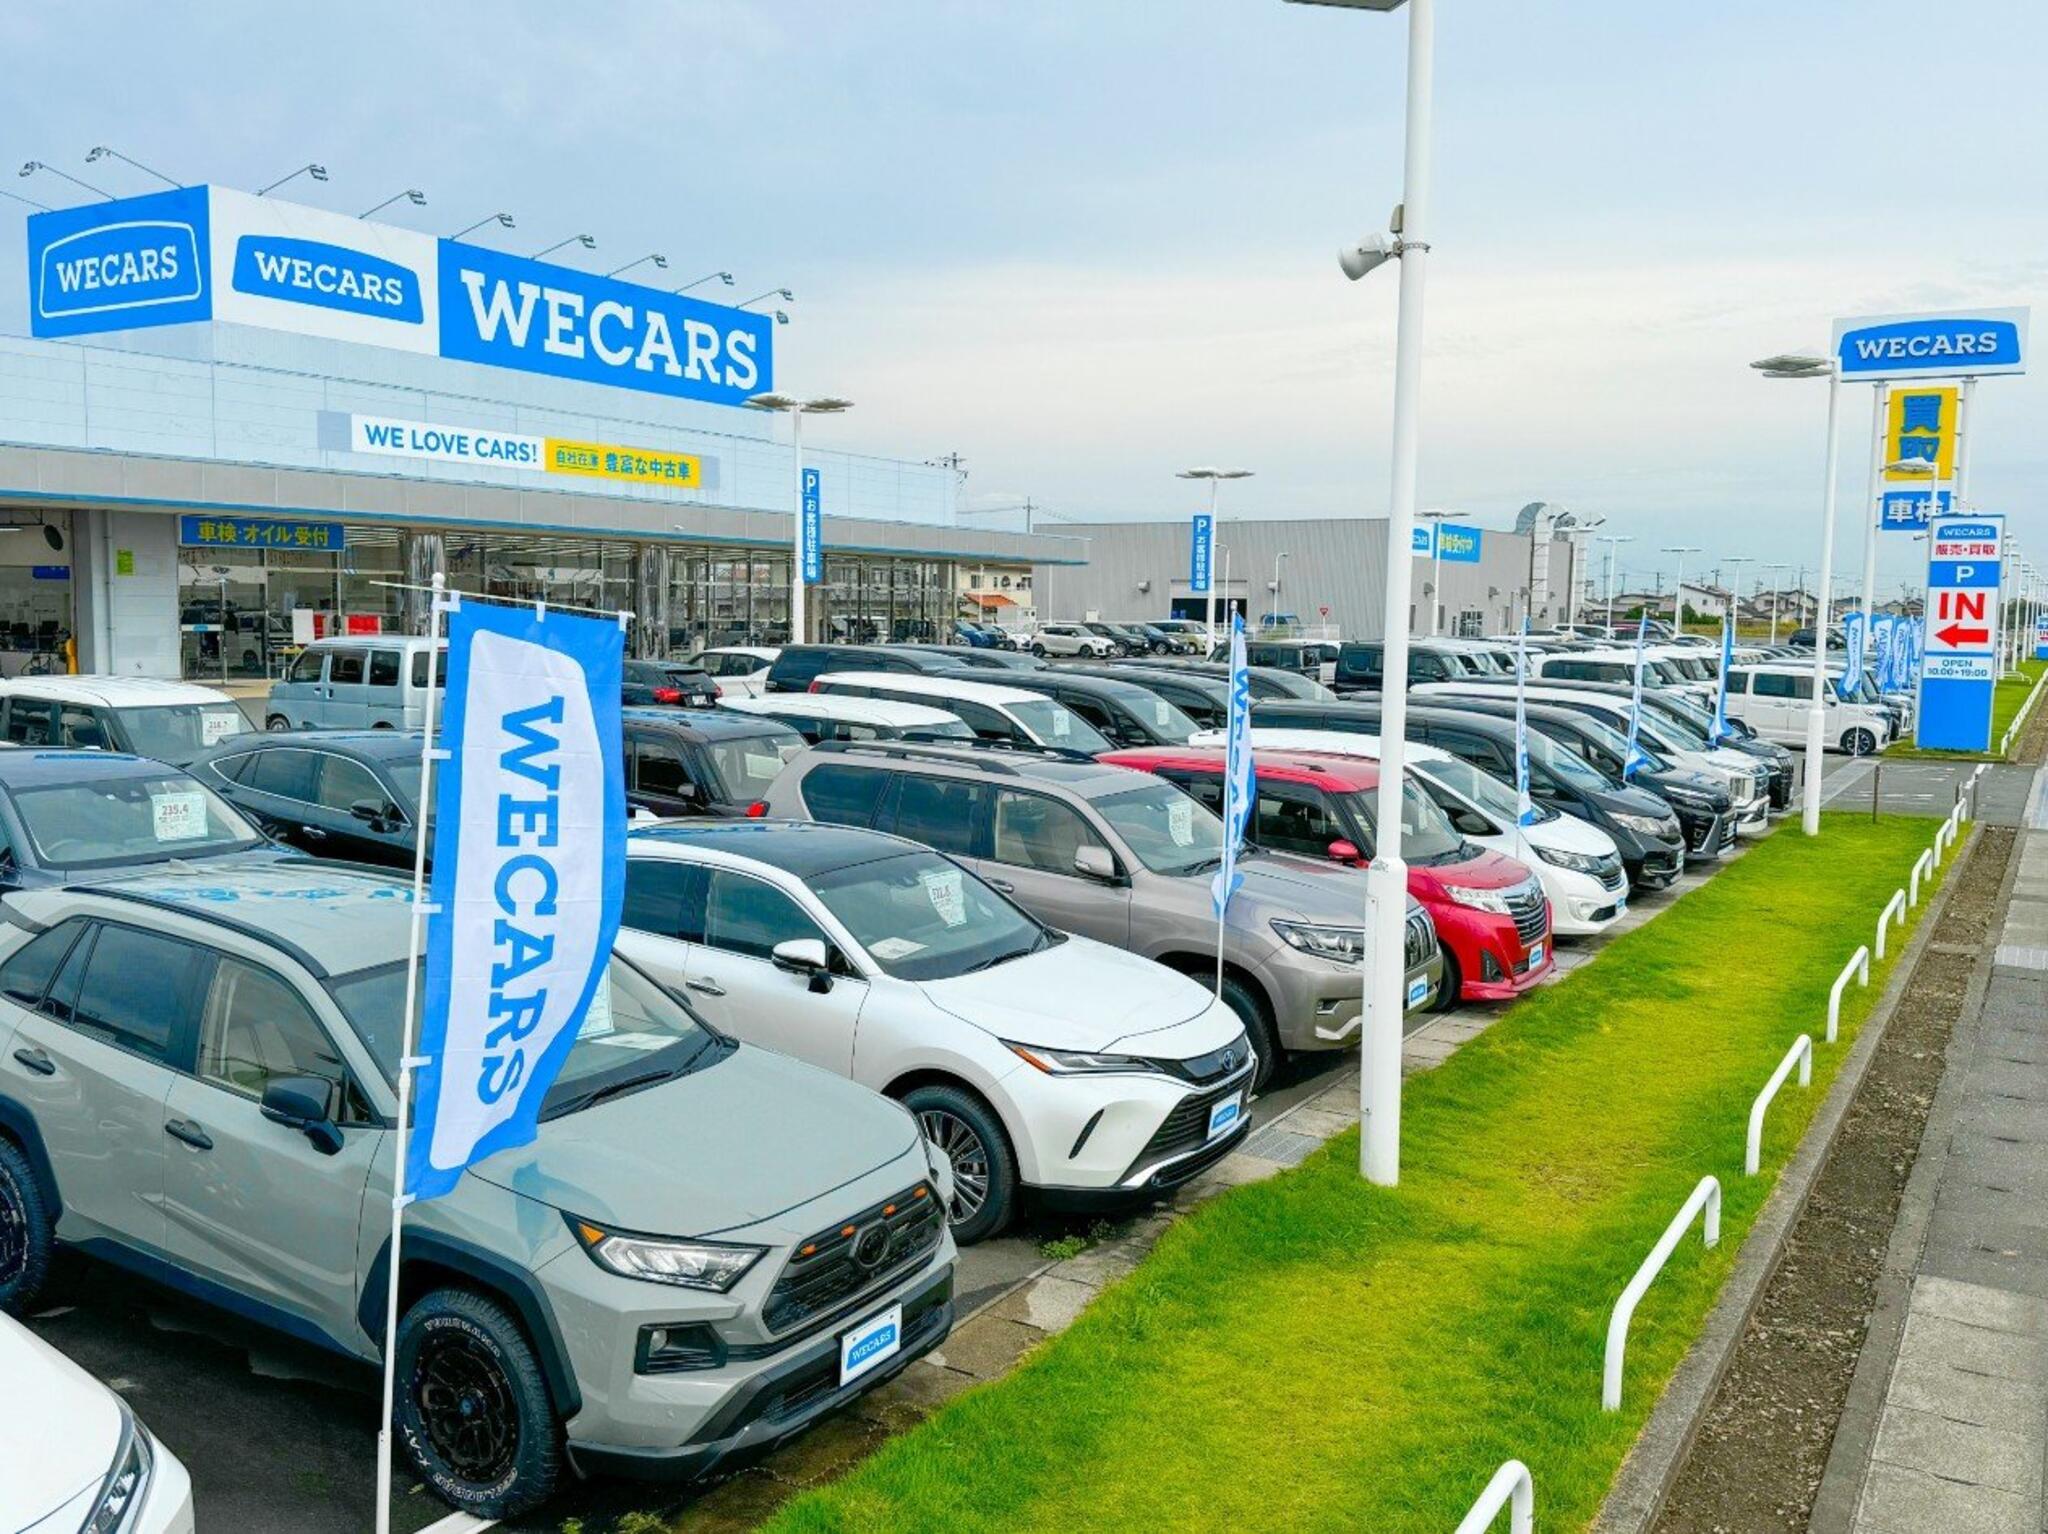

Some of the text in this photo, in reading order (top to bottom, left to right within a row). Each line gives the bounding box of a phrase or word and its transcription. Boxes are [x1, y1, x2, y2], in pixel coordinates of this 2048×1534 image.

[57, 246, 178, 292] WECARS
[254, 251, 403, 305] WECARS
[460, 269, 758, 391] WECARS
[1856, 332, 1998, 360] WECARS
[365, 424, 538, 463] WE LOVE CARS!
[605, 452, 690, 480] 豊富な中古車
[806, 474, 816, 494] P
[1198, 519, 1207, 532] P
[1943, 528, 1991, 537] WECARS
[1956, 565, 1975, 583] P
[1939, 592, 1986, 621] IN
[1942, 659, 1973, 668] OPEN
[477, 695, 565, 1105] WECARS
[851, 1330, 892, 1362] WECARS
